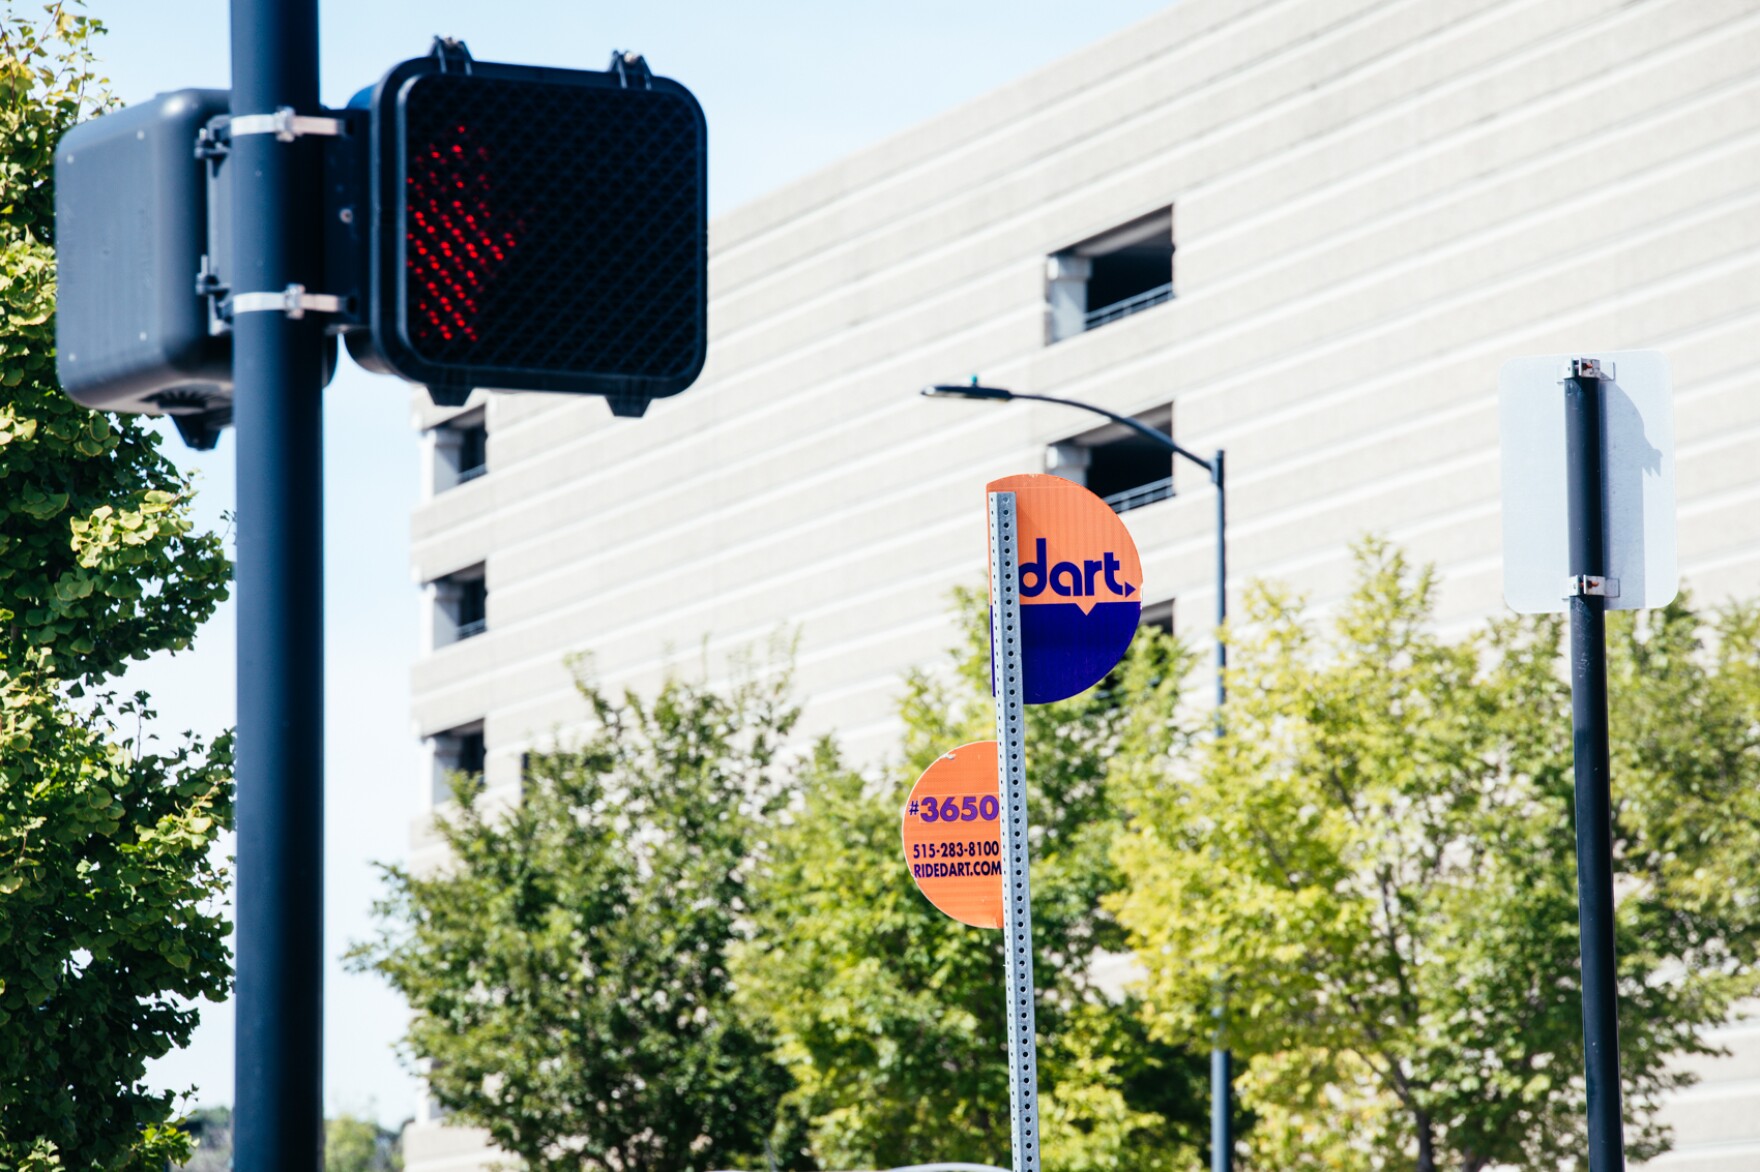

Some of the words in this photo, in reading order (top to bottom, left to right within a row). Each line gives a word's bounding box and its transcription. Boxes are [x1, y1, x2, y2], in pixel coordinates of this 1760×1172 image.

[1018, 538, 1123, 597] dart
[909, 795, 999, 822] #3650
[913, 841, 999, 858] 515-283-8100
[913, 861, 1002, 878] RIDEDART.COM
